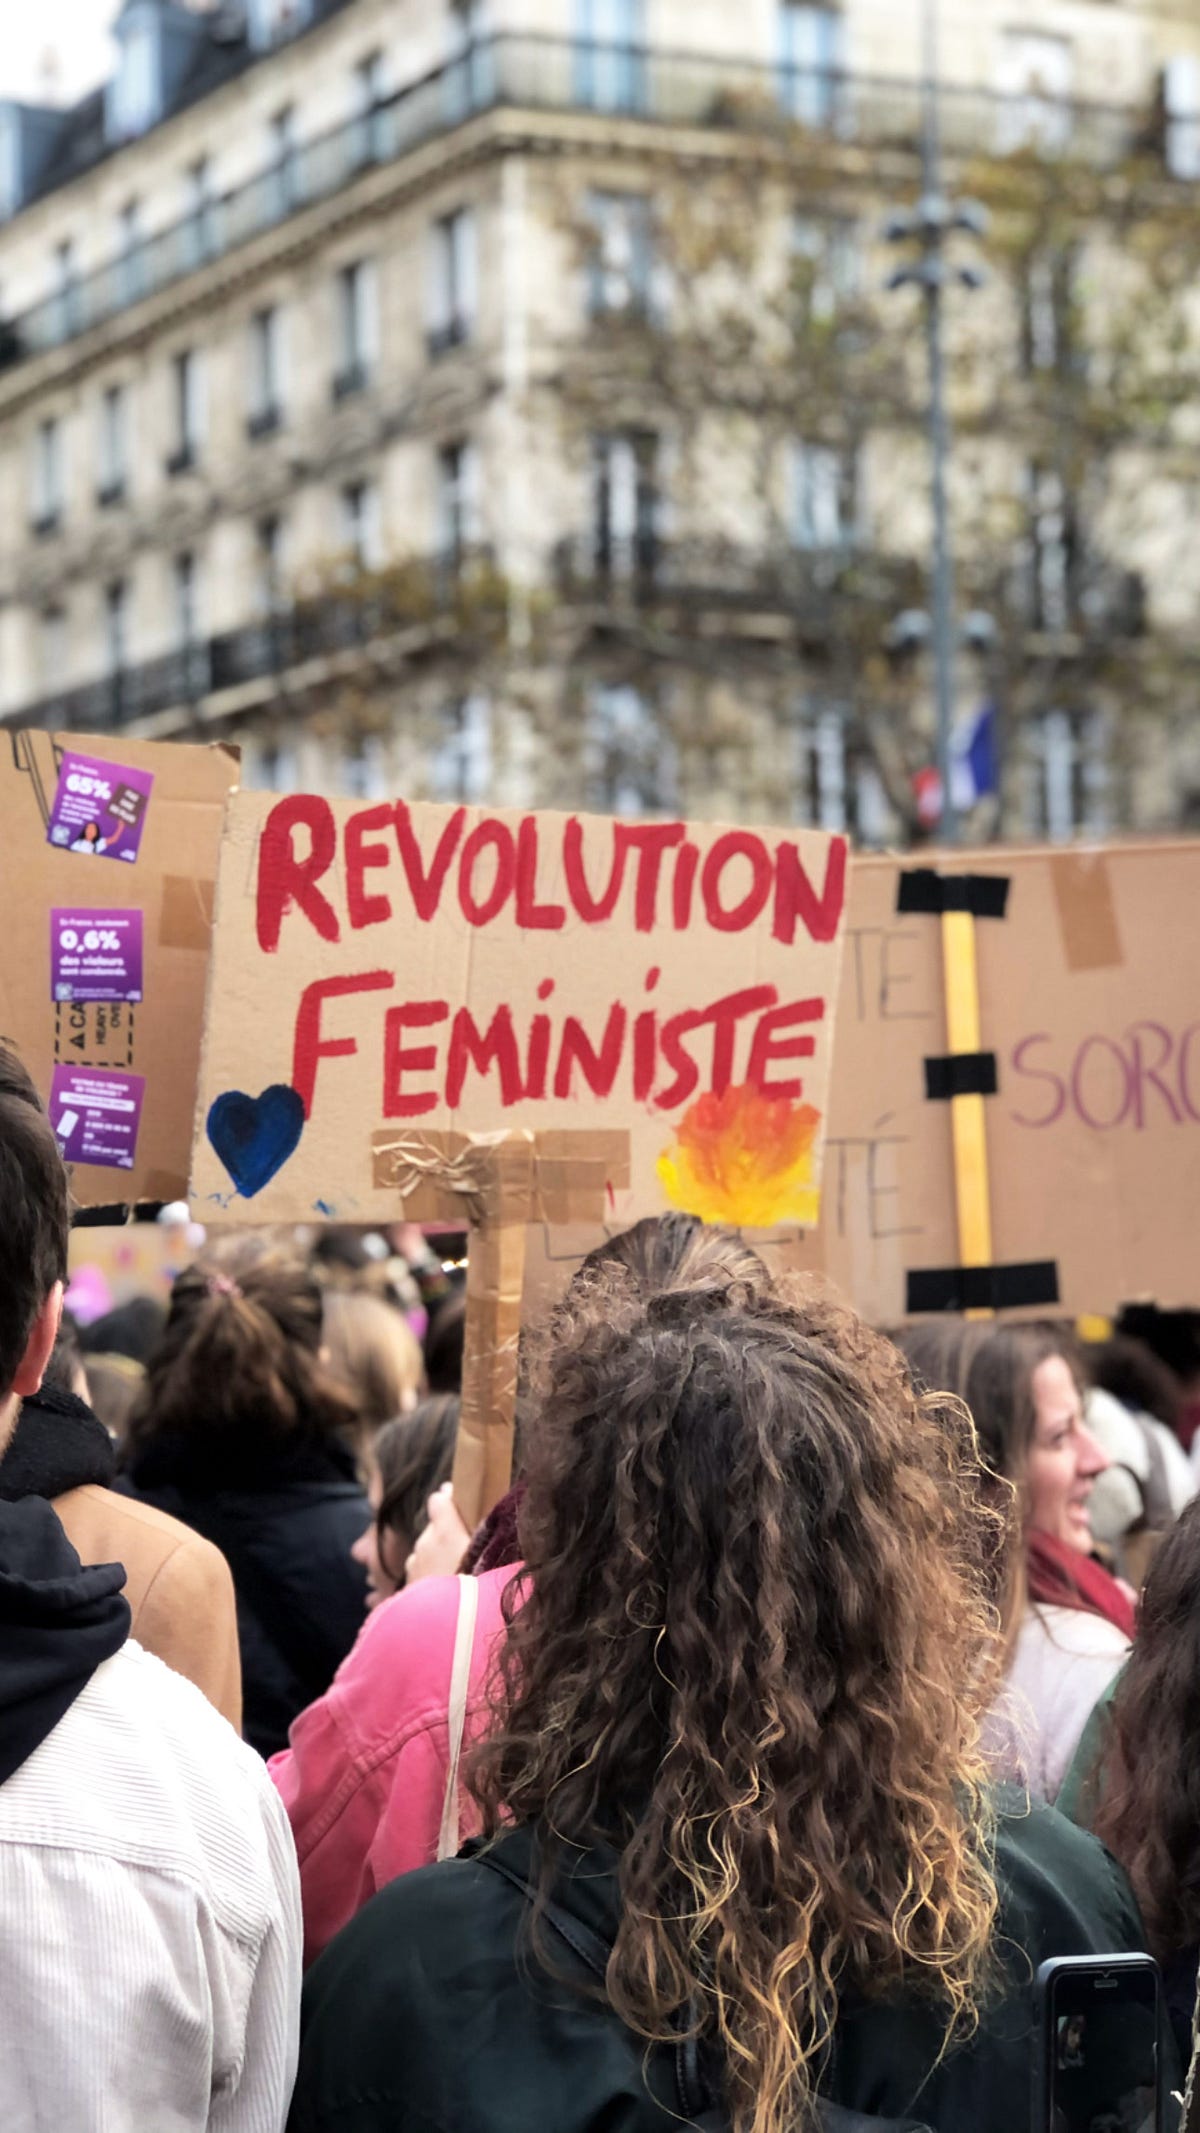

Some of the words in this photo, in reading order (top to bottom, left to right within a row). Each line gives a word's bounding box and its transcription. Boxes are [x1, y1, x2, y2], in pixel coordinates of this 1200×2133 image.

[66, 773, 112, 800] 65%
[256, 793, 848, 953] REVOLUTION
[60, 929, 120, 953] 0,6%
